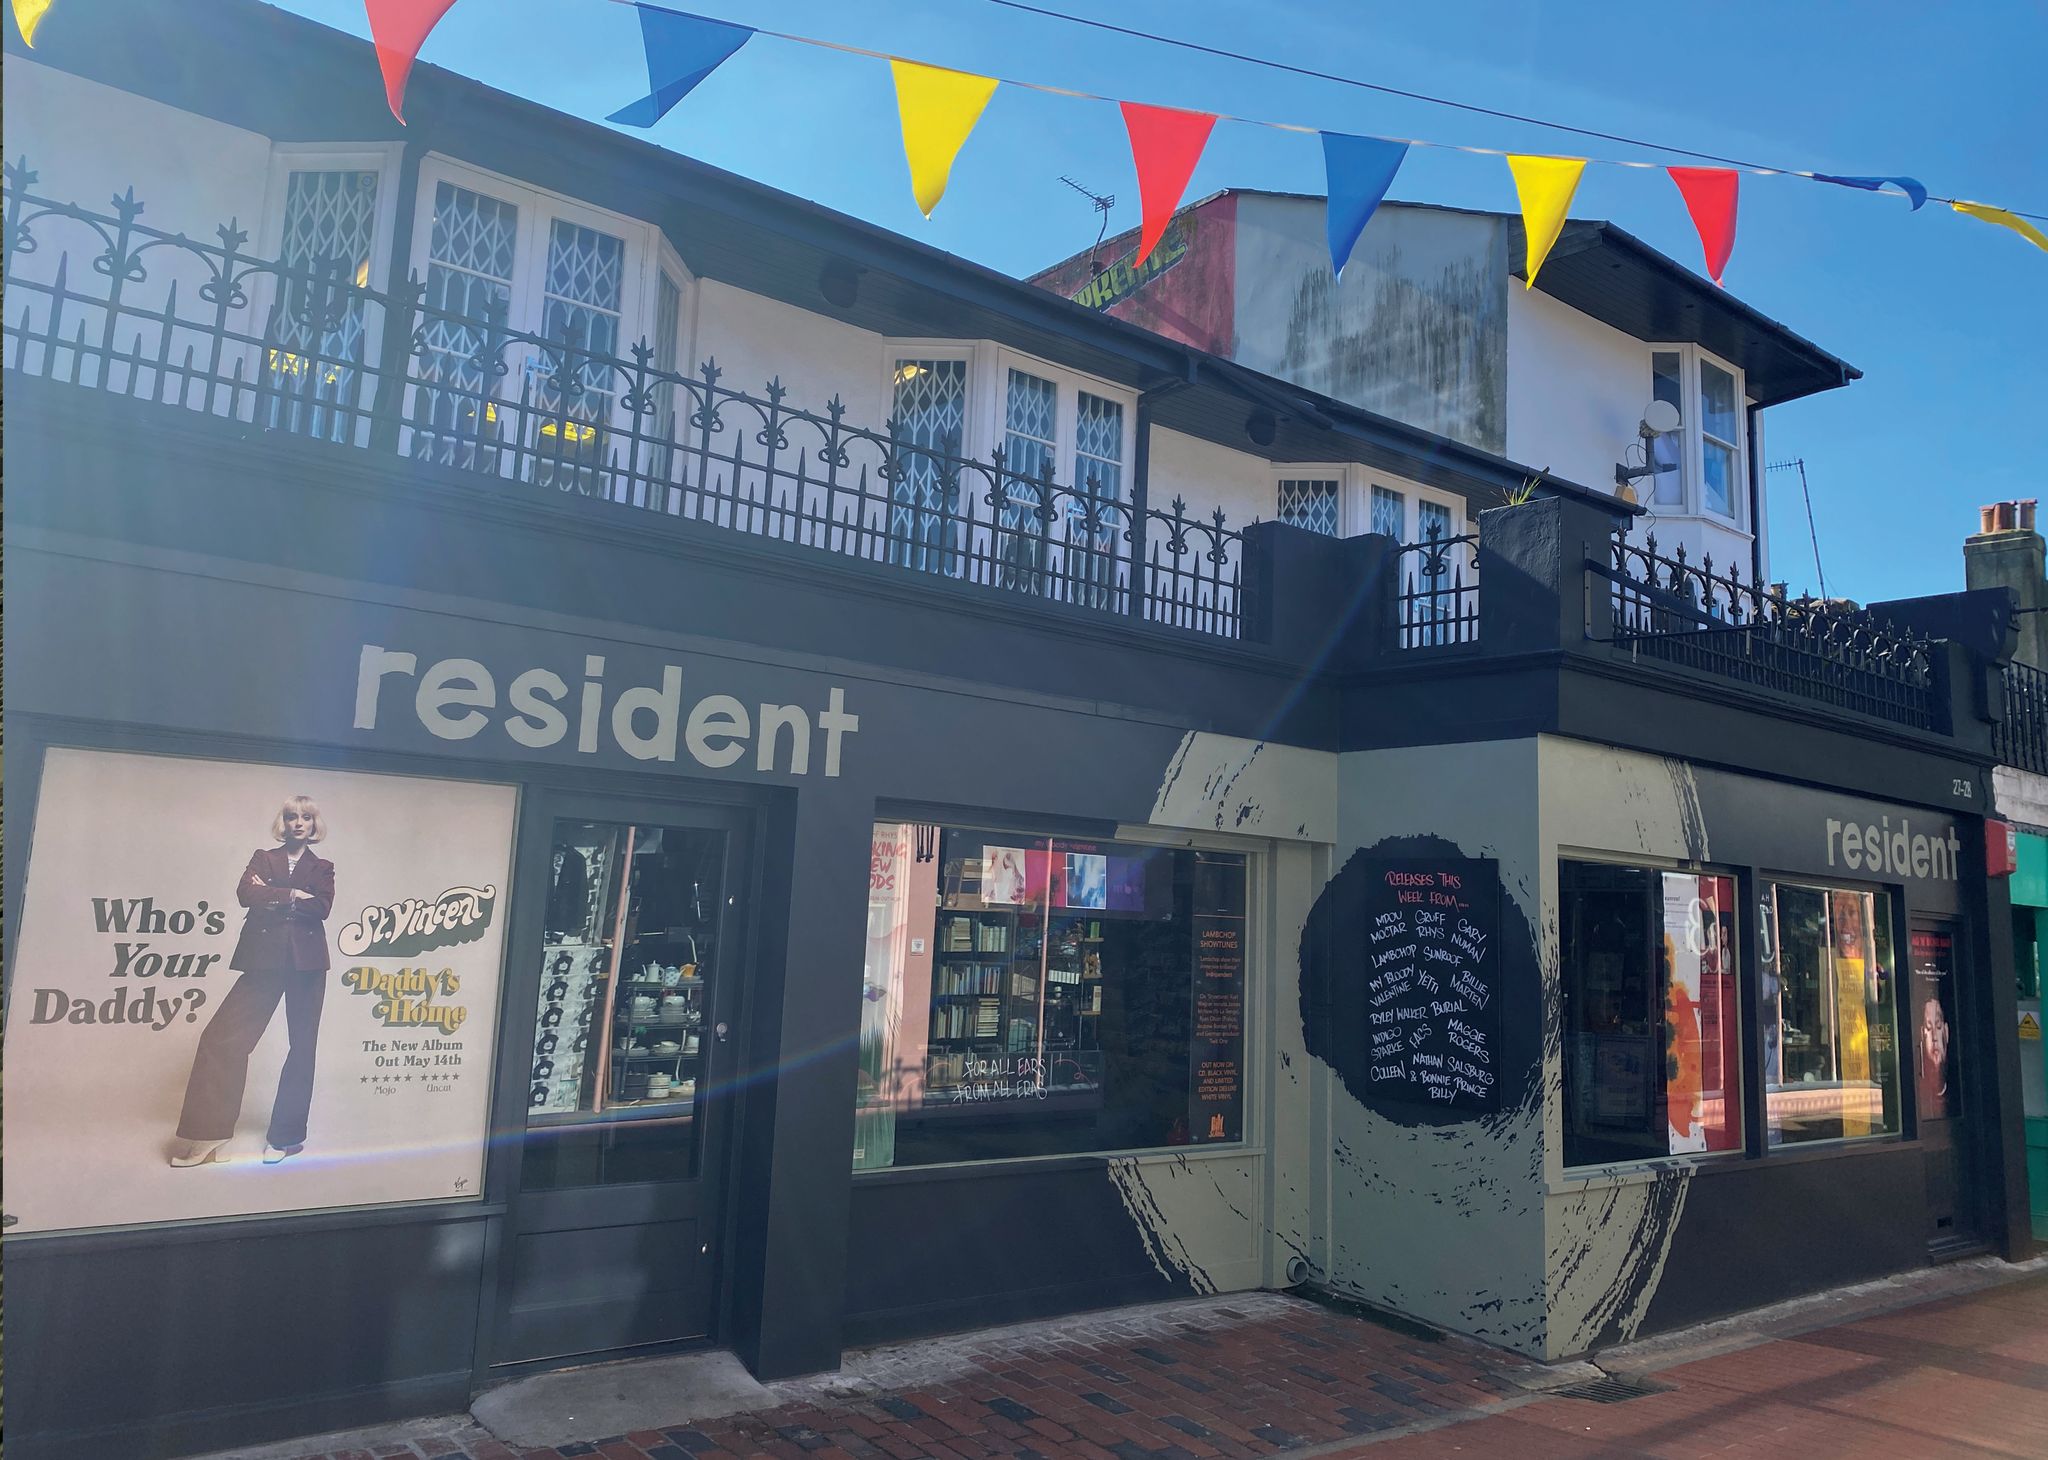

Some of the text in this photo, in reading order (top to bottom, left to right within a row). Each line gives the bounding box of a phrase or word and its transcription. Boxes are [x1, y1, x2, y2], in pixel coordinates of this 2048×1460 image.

[353, 644, 859, 777] resident
[1952, 779, 1972, 798] 27-28
[1826, 815, 1960, 881] resident
[1385, 870, 1461, 889] RELEASES THIS
[1398, 890, 1424, 903] WEEK
[91, 897, 226, 935] Who's
[1375, 910, 1402, 927] MDOU
[1414, 909, 1446, 925] GRUFF
[1202, 930, 1237, 939] LAMBCHOP
[1370, 922, 1407, 944] MOCTAR
[1416, 925, 1445, 939] RHYS
[1457, 918, 1487, 944] GARY
[1200, 940, 1238, 949] SHOWTUNES
[1371, 944, 1417, 968] LAMBCHOP
[1451, 933, 1486, 963] NUMAN
[109, 943, 221, 978] Your
[1423, 946, 1463, 967] SUNROOF
[342, 966, 461, 1004] Daddy's
[1369, 963, 1415, 992] MY BLOODY
[1462, 970, 1488, 995] BILLIE
[1369, 980, 1412, 1007] VALENTINE
[1449, 974, 1490, 1010] MARTEN
[29, 986, 207, 1032] Daddy?
[372, 999, 467, 1036] Home
[1369, 1006, 1428, 1025] RYLEY WALKER
[1430, 999, 1468, 1017] BURIAL
[362, 1039, 463, 1051] The New Album
[1372, 1026, 1402, 1045] INDIGO
[1409, 1023, 1432, 1049] FACS
[1448, 1032, 1490, 1064] ROGERS
[375, 1054, 462, 1068] Out May 14th
[962, 1057, 1047, 1079] FOR ALL EARS
[1370, 1060, 1406, 1081] COLLEEN
[1412, 1052, 1494, 1085] NATHAN SALSBURG
[374, 1083, 451, 1095] Mojo Uncut
[953, 1079, 1047, 1104] FROM ALL ERAS
[1410, 1070, 1487, 1098] & BONNIE PRINCE
[1428, 1086, 1457, 1104] BILLY
